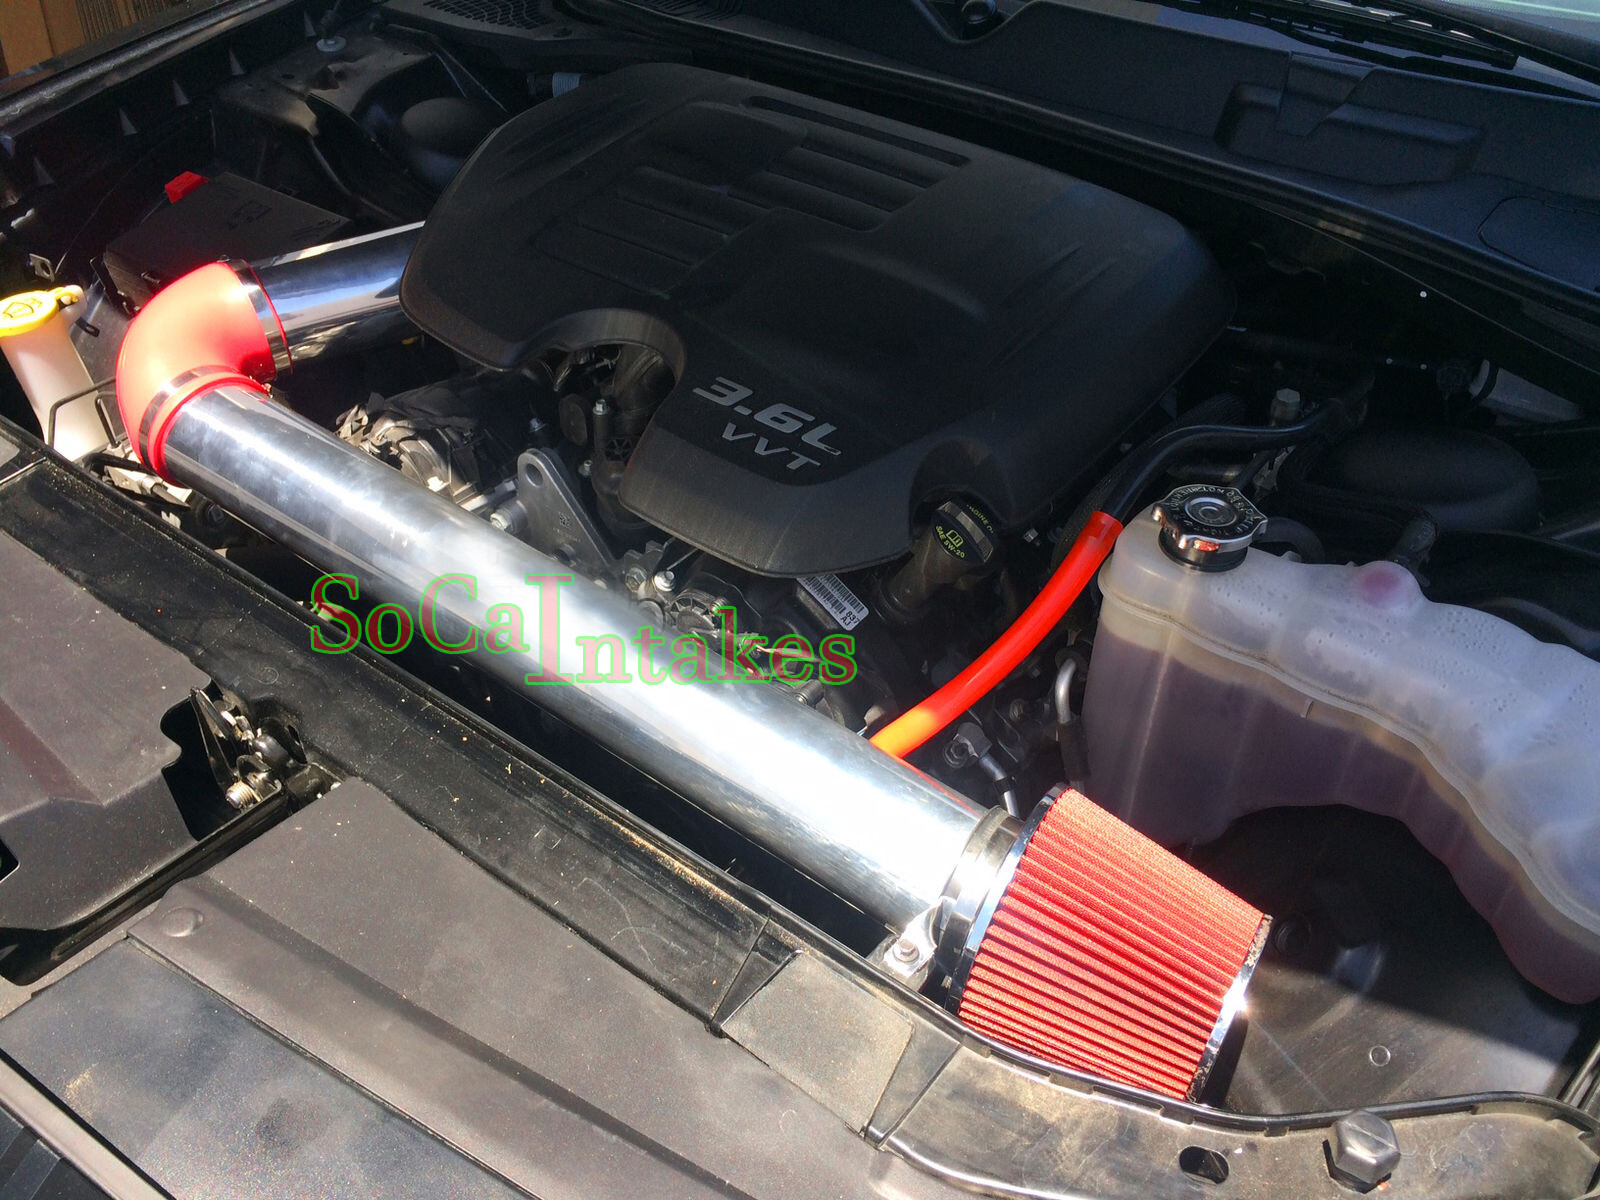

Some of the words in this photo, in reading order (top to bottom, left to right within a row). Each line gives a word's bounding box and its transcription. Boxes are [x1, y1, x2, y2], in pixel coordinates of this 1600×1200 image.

[692, 376, 841, 456] 3.6L
[721, 422, 821, 470] VVT
[943, 540, 965, 558] 5W-20
